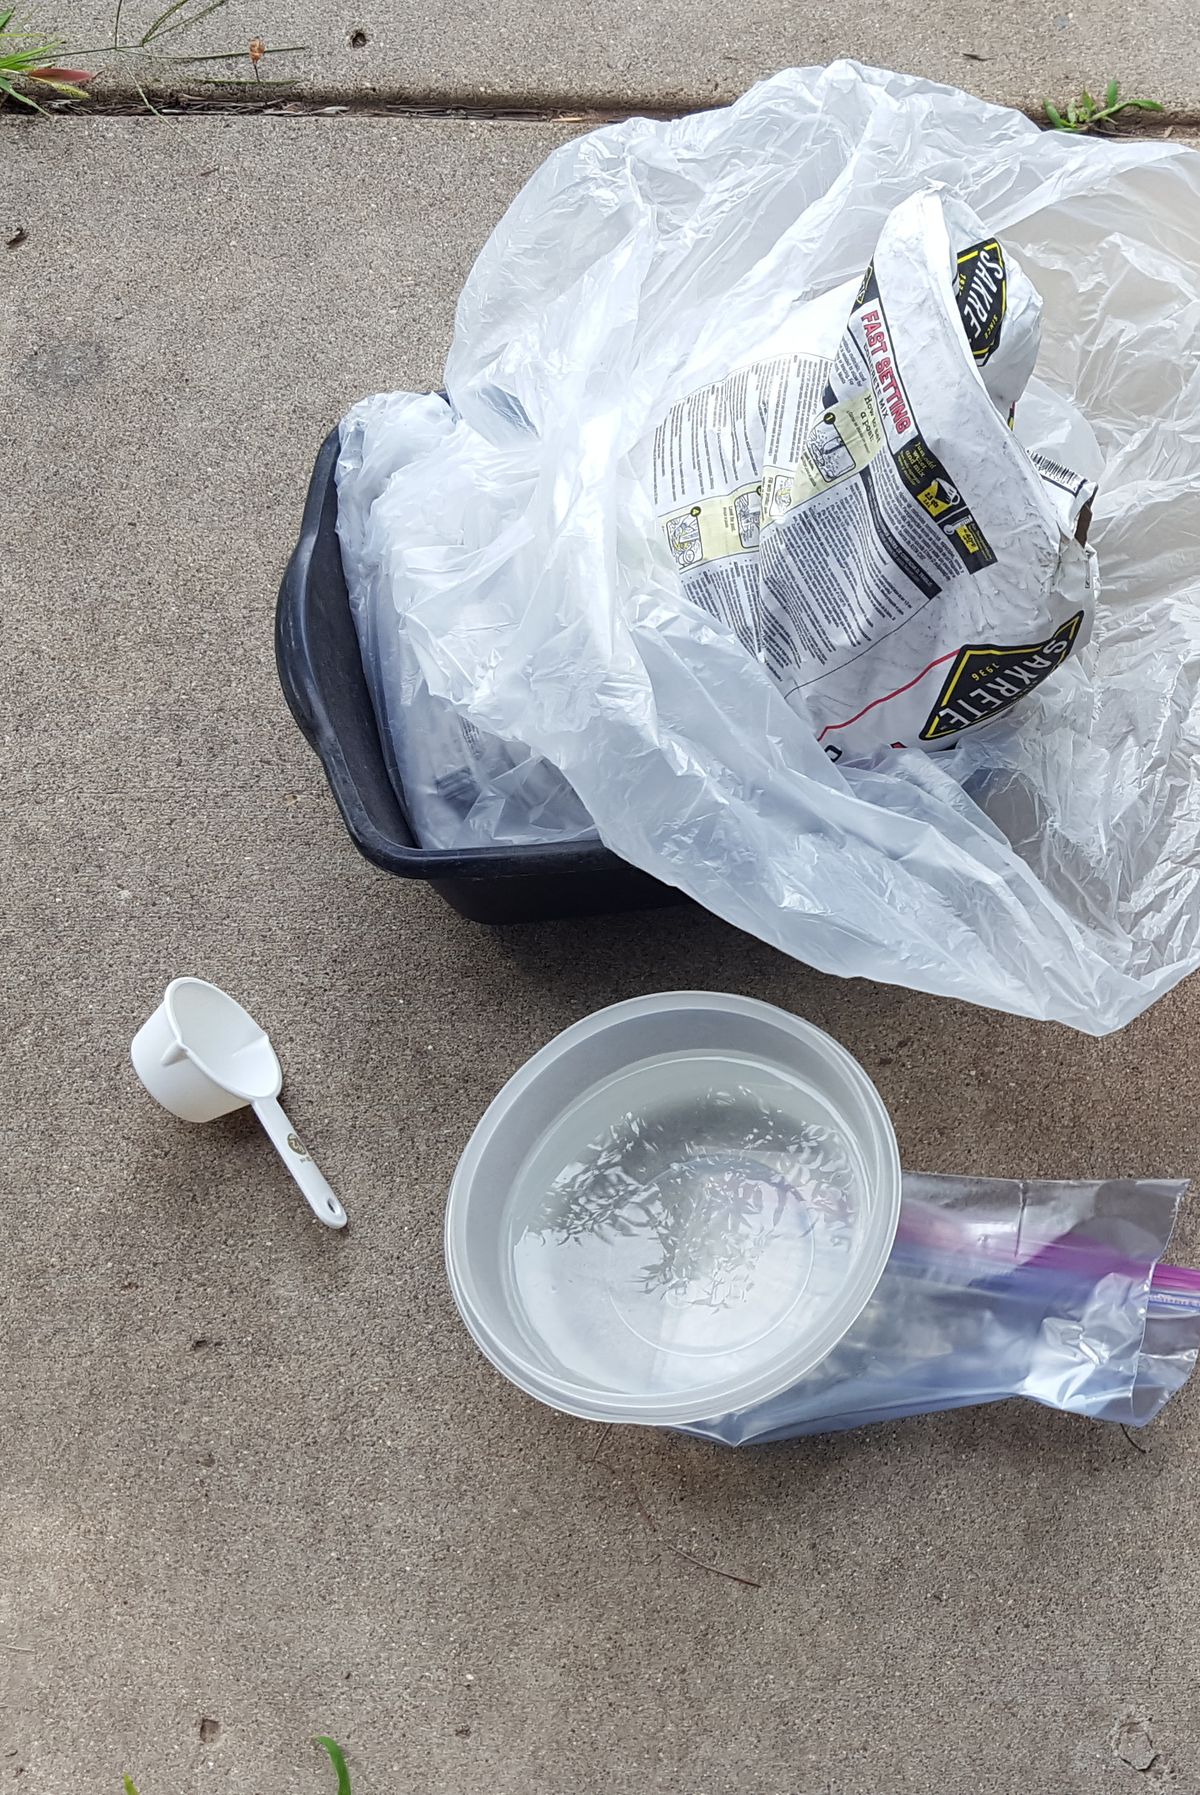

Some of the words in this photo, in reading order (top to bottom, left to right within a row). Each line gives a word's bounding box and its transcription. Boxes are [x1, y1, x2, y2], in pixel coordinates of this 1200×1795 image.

[963, 250, 1004, 339] SAKRE
[984, 314, 999, 340] SINCE
[860, 309, 888, 357] FAST
[875, 356, 912, 435] SETTING
[863, 343, 882, 399] CONCRETE
[878, 399, 890, 420] MIX
[864, 395, 875, 417] How
[938, 638, 1068, 730] SAKRETE
[971, 662, 1000, 682] 1936
